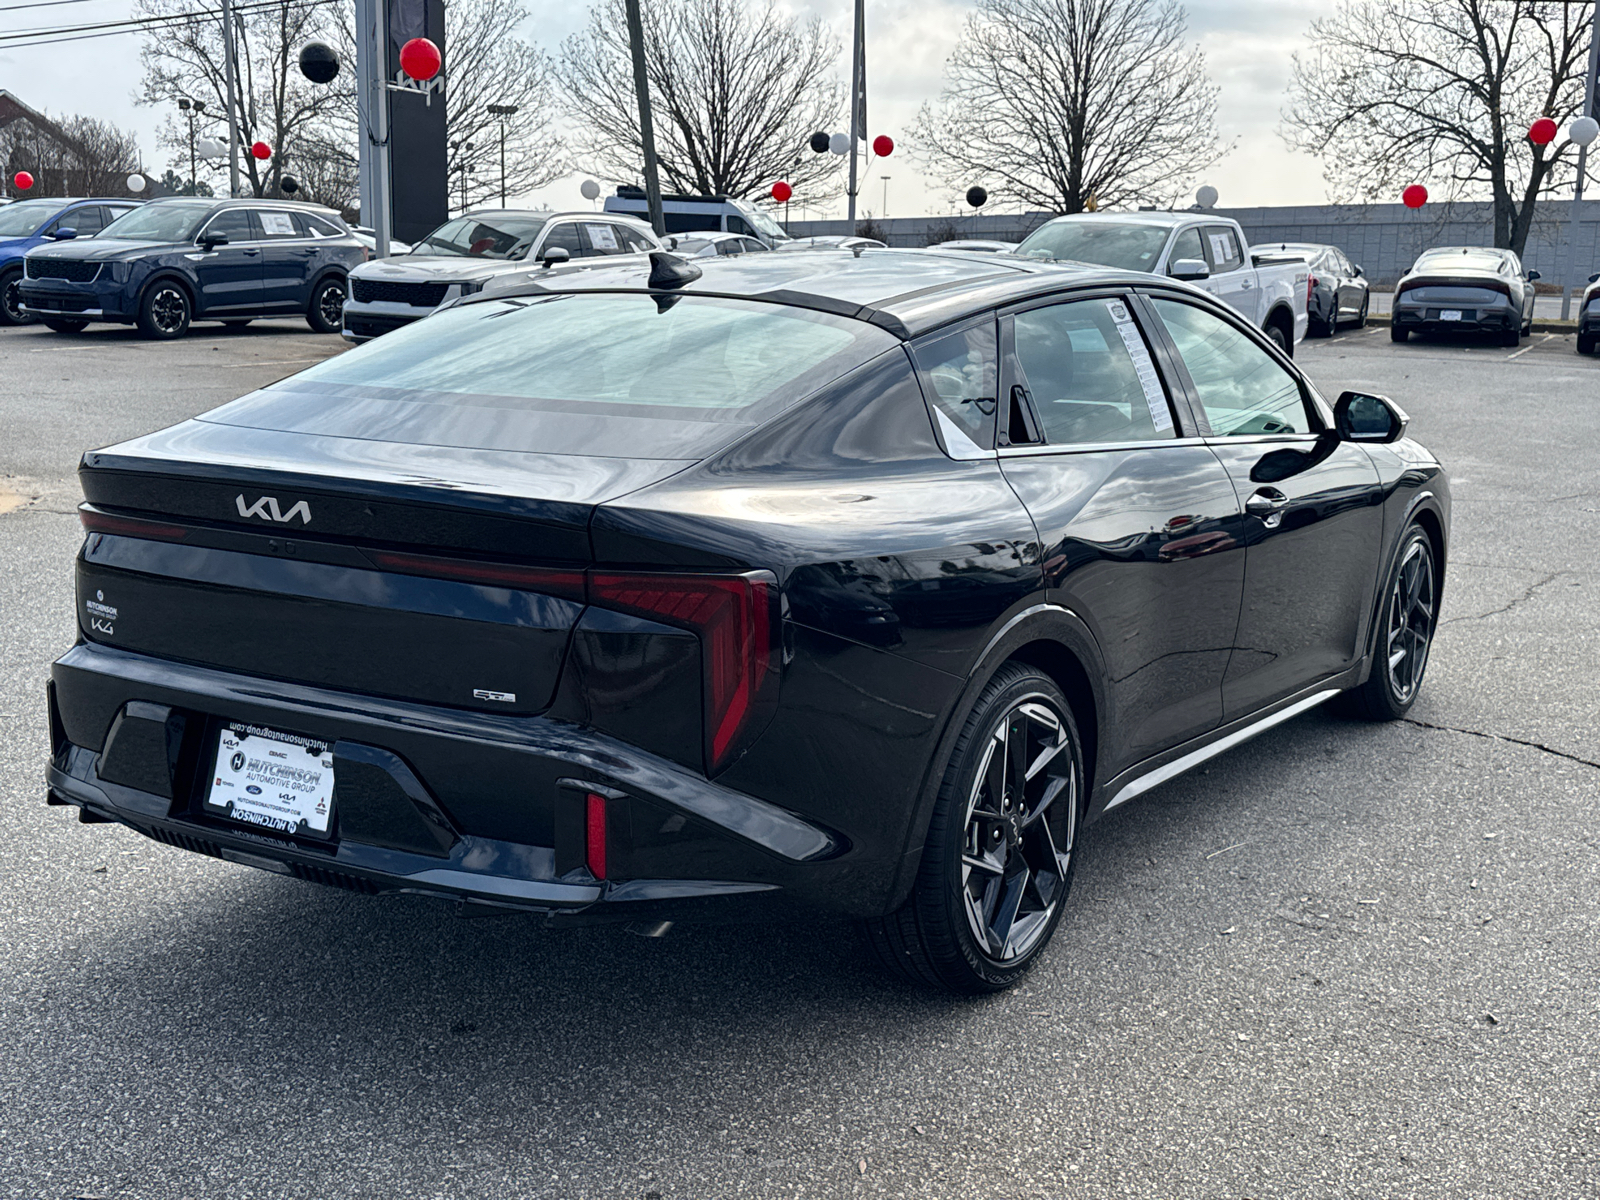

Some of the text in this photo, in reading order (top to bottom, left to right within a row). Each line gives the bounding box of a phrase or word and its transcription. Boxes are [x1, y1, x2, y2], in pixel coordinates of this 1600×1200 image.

[235, 493, 312, 525] KIA
[91, 617, 114, 636] K4
[230, 722, 327, 751] Hutchinsonautogroup.com
[269, 751, 287, 759] GMC
[246, 758, 322, 786] HUTCHINSON
[246, 772, 315, 793] AUTOMOTIVE GROUP
[231, 808, 286, 830] HUTCHINSON
